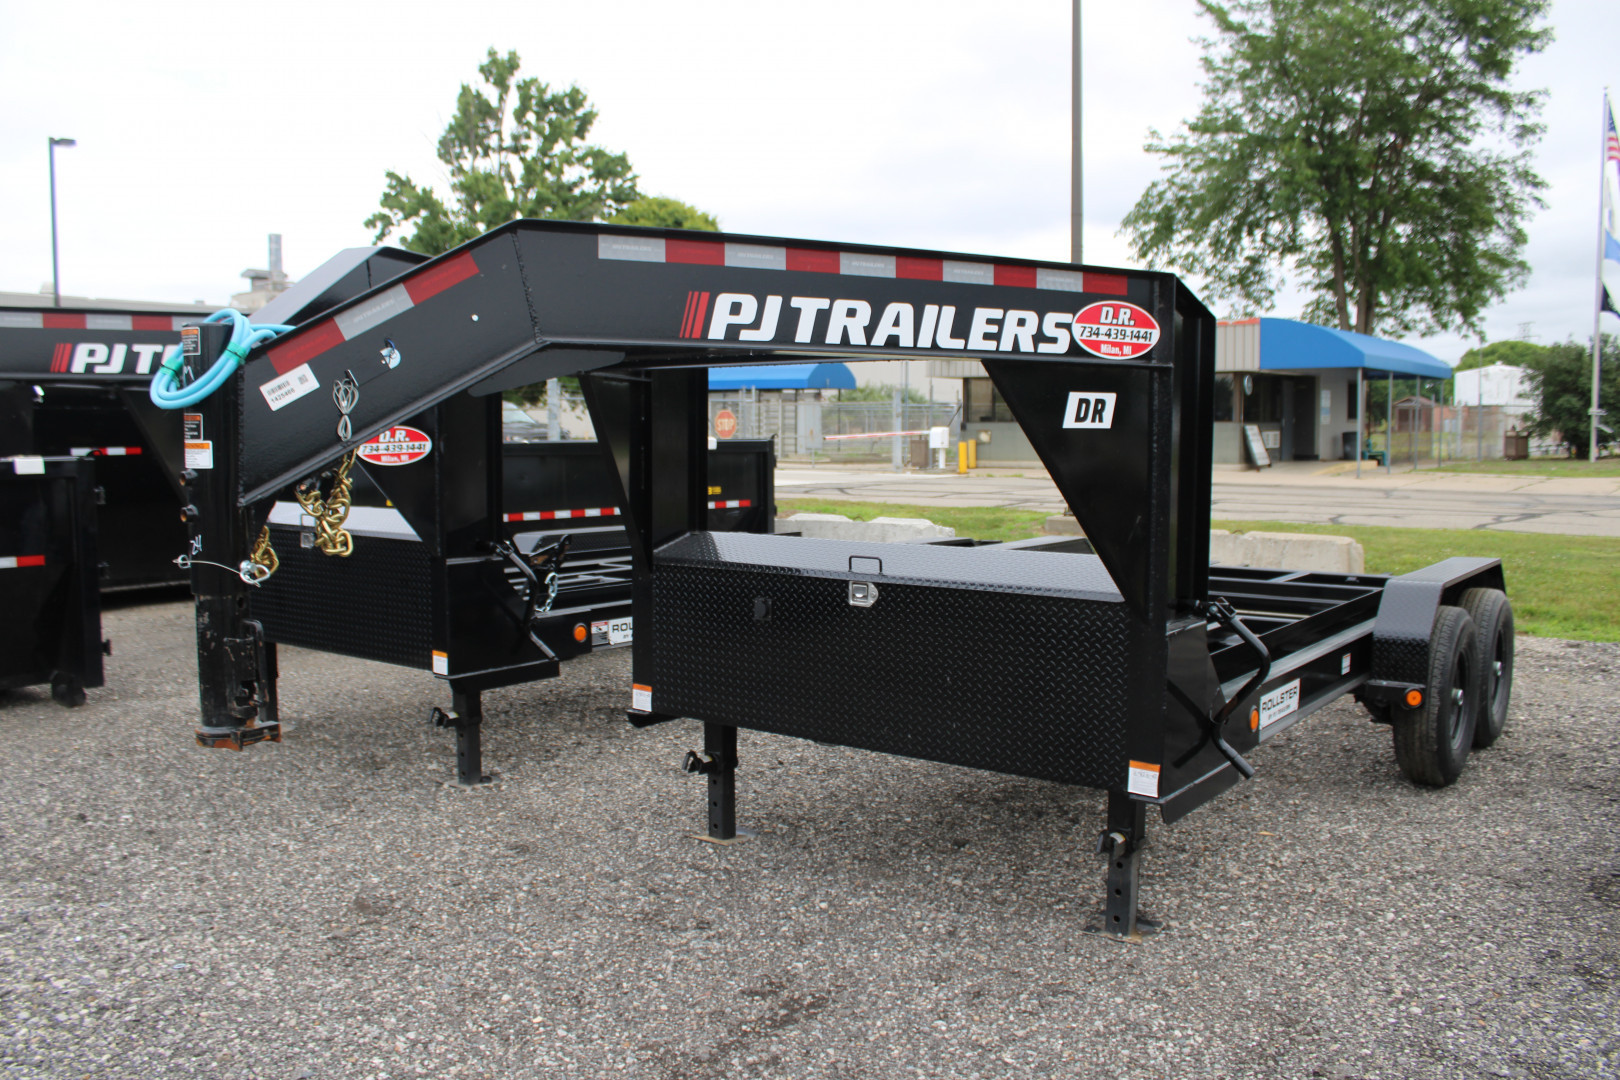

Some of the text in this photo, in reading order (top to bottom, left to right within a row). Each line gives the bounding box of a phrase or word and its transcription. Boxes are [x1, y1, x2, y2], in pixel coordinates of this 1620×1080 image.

[708, 292, 1074, 354] PJ TRAILERS
[1099, 306, 1136, 326] D.R.
[1079, 325, 1153, 342] 734-439-1441
[70, 342, 128, 374] PJ
[1100, 343, 1132, 356] Milan, MI
[1074, 396, 1106, 424] DR
[717, 418, 734, 431] STOP
[1262, 686, 1298, 714] ROLLSTER
